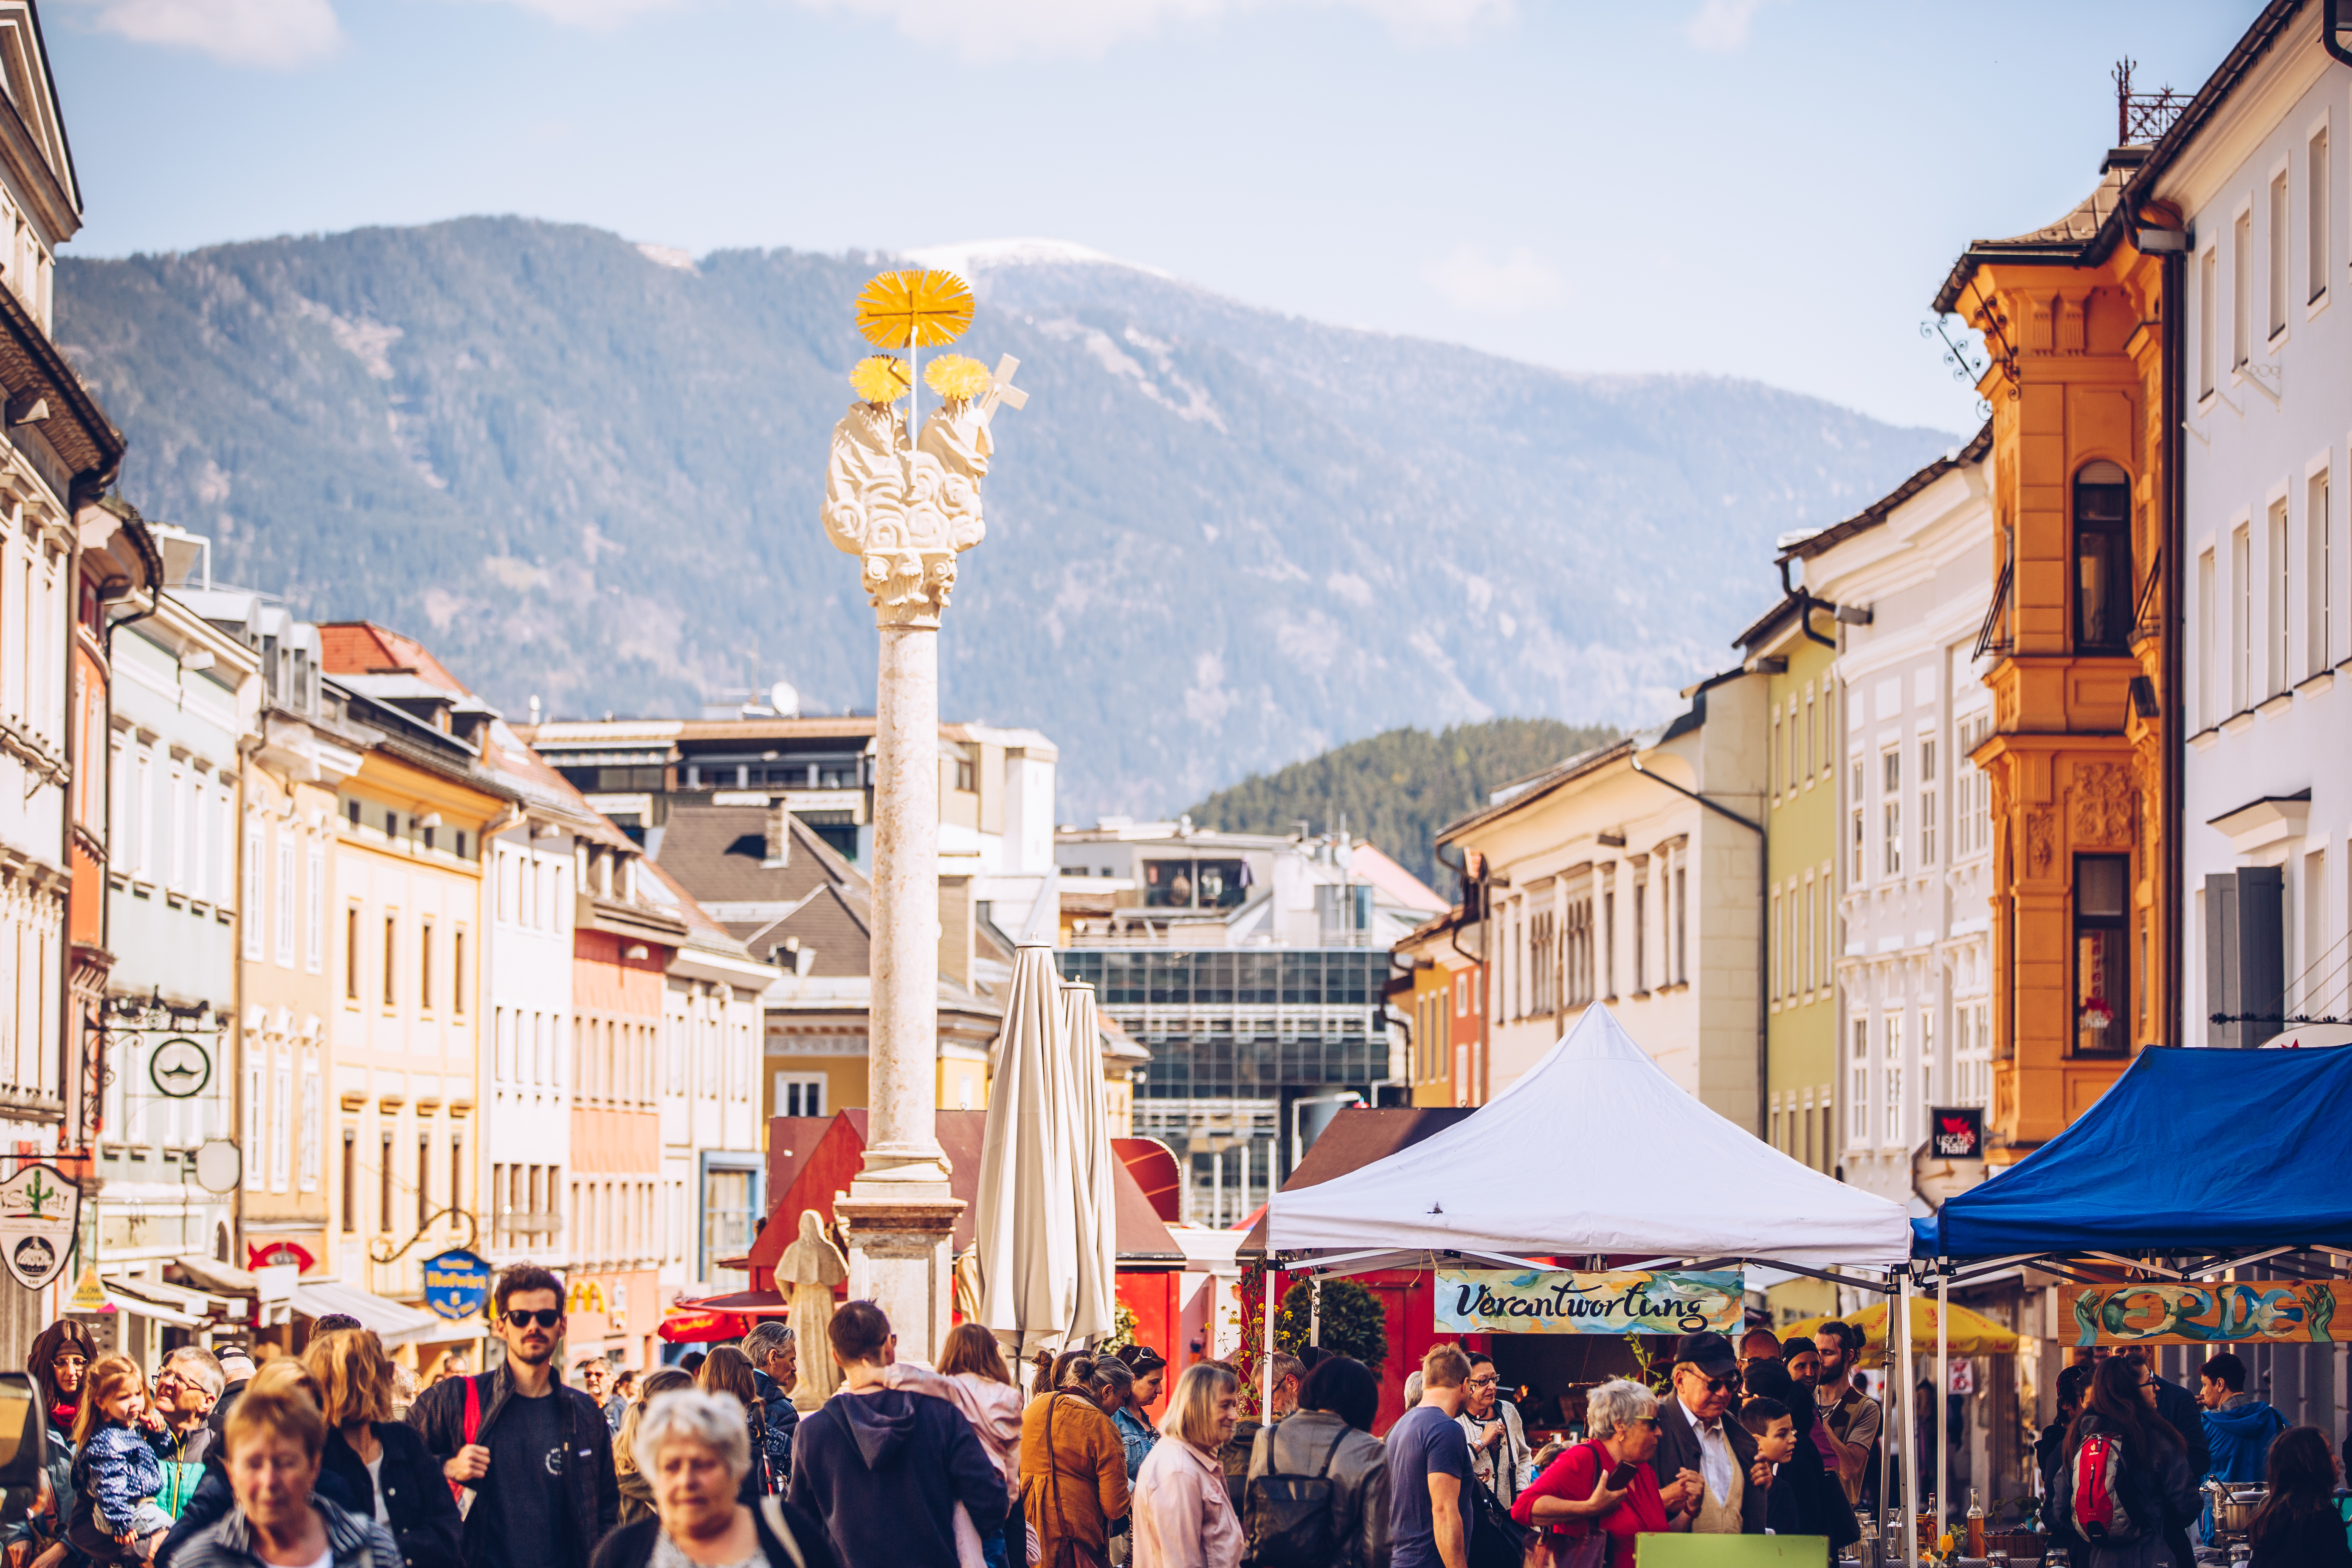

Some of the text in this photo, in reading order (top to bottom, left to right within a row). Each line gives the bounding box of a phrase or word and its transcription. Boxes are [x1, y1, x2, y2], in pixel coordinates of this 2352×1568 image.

[1941, 1140, 1971, 1154] hair
[0, 1189, 69, 1211] ¡Saud!
[426, 1271, 487, 1289] Hofwirt
[1456, 1280, 1708, 1333] Verantwortung
[2102, 1284, 2303, 1340] ERDE
